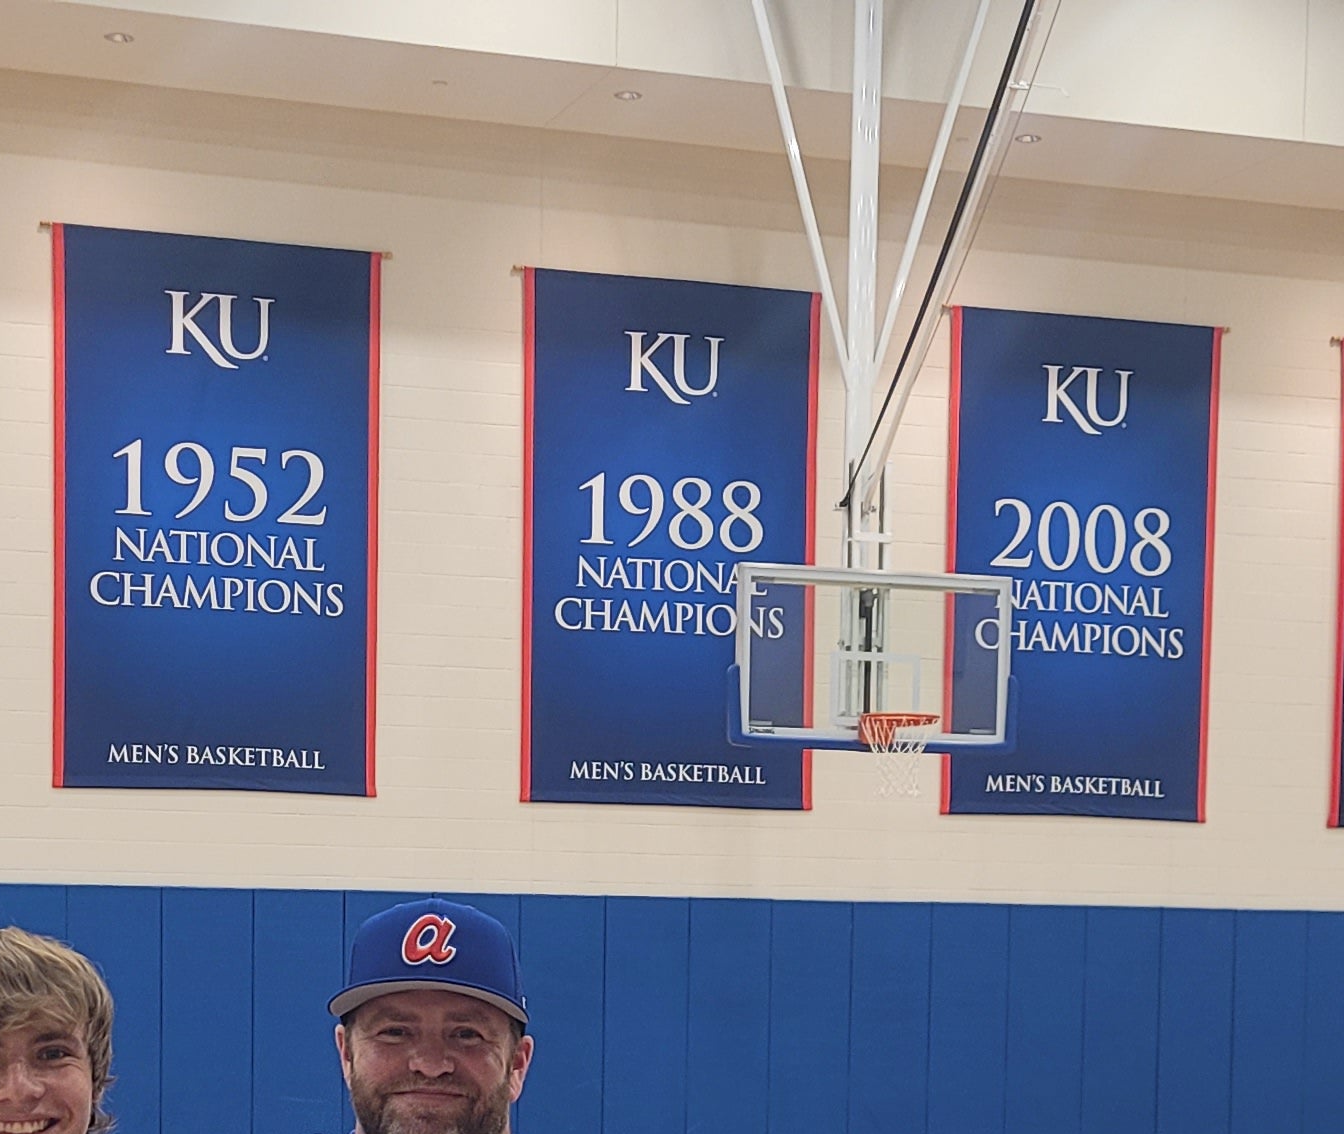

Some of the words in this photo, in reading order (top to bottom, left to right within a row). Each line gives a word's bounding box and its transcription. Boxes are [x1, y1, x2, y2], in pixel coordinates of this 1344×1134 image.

[164, 290, 275, 369] KU
[624, 331, 724, 405] KU
[1042, 364, 1133, 435] KU
[113, 439, 327, 526] 1952
[578, 472, 764, 553] 1988
[112, 527, 325, 572] NATIONAL
[990, 498, 1173, 577] 2008
[89, 570, 344, 617] CHAMPIONS
[108, 744, 179, 764] MEN'S
[186, 745, 325, 770] BASKETBALL
[570, 761, 634, 781] MEN'S
[640, 763, 766, 785] BASKETBALL
[985, 775, 1045, 793] MEN'S
[1050, 776, 1165, 798] BASKETBALL
